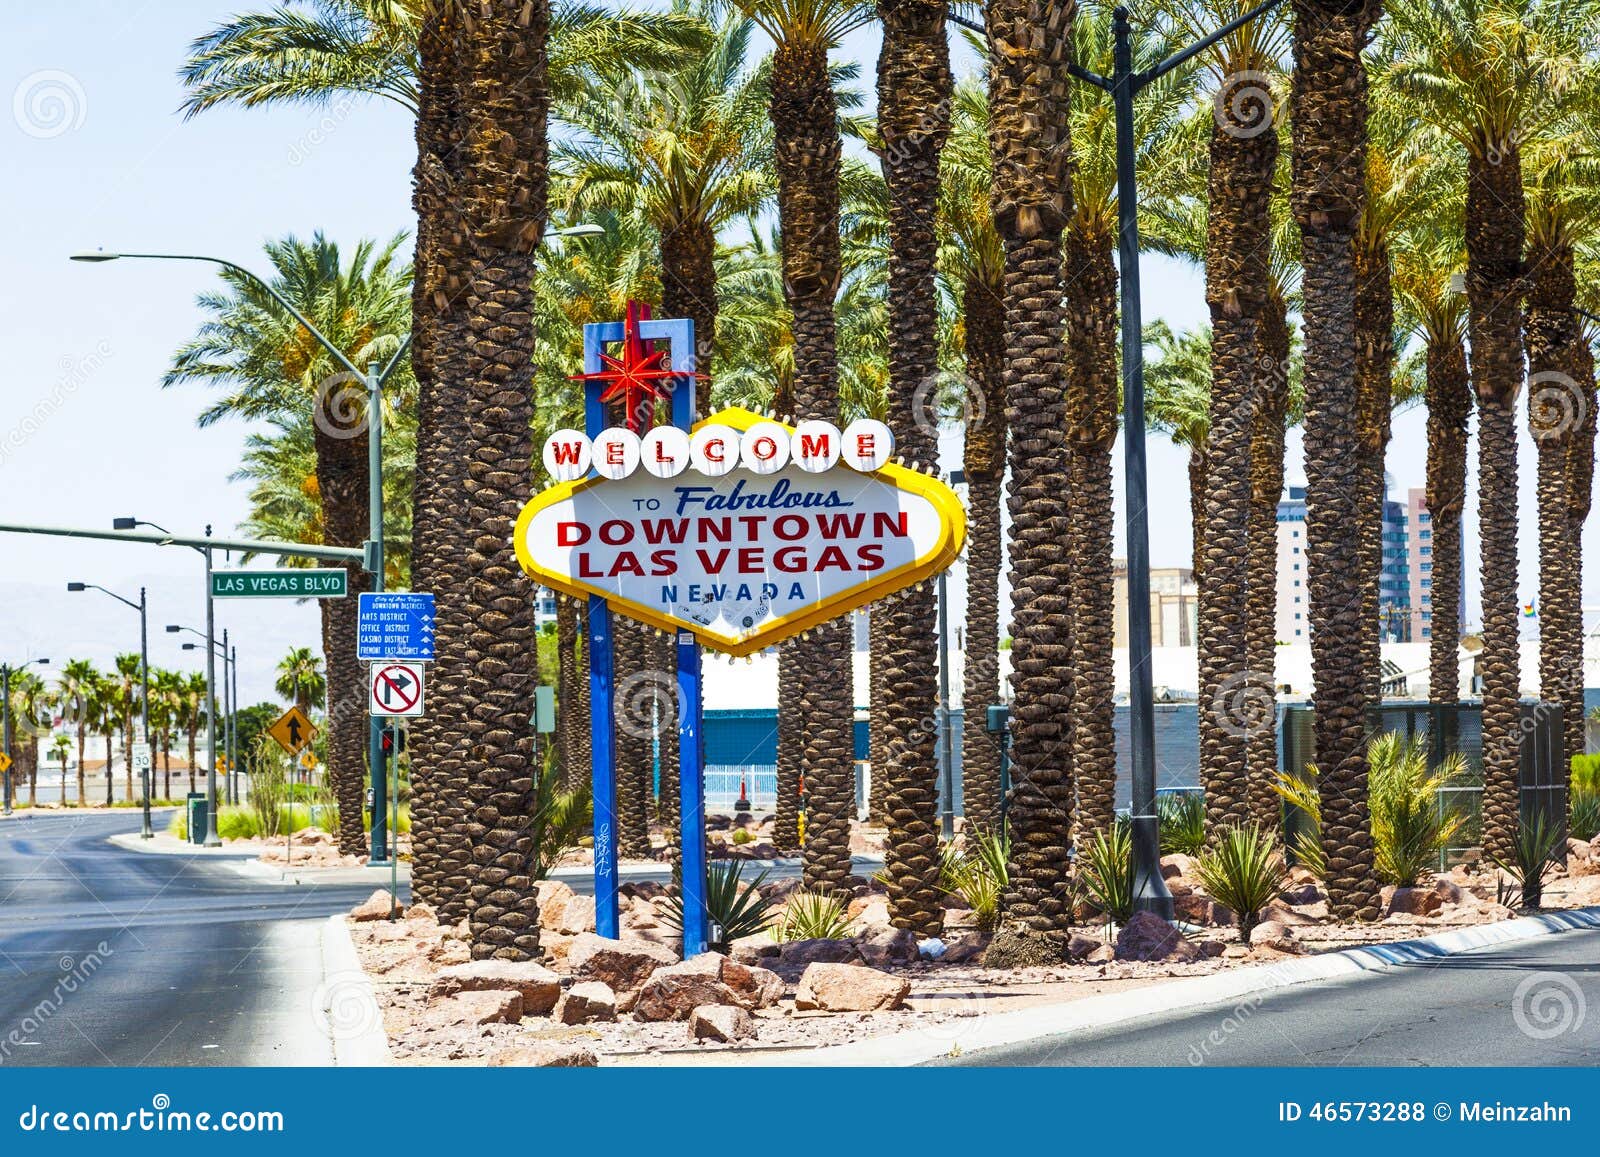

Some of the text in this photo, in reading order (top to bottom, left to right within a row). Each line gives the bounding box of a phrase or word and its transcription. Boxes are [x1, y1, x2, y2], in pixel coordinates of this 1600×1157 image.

[552, 433, 875, 466] WELCOME
[633, 478, 854, 516] TO Fabulous
[557, 511, 908, 547] DOWNTOWN
[578, 544, 886, 578] LAS VEGAS
[216, 577, 341, 591] LAS VEGAS BLVD
[661, 582, 806, 603] NEVADA
[361, 613, 407, 621] ARTS DISTRICT
[360, 624, 410, 632] OFFICE DISTRICT
[360, 636, 409, 644] CASINO DISTRICT
[384, 646, 396, 654] EAST
[136, 756, 149, 766] 30
